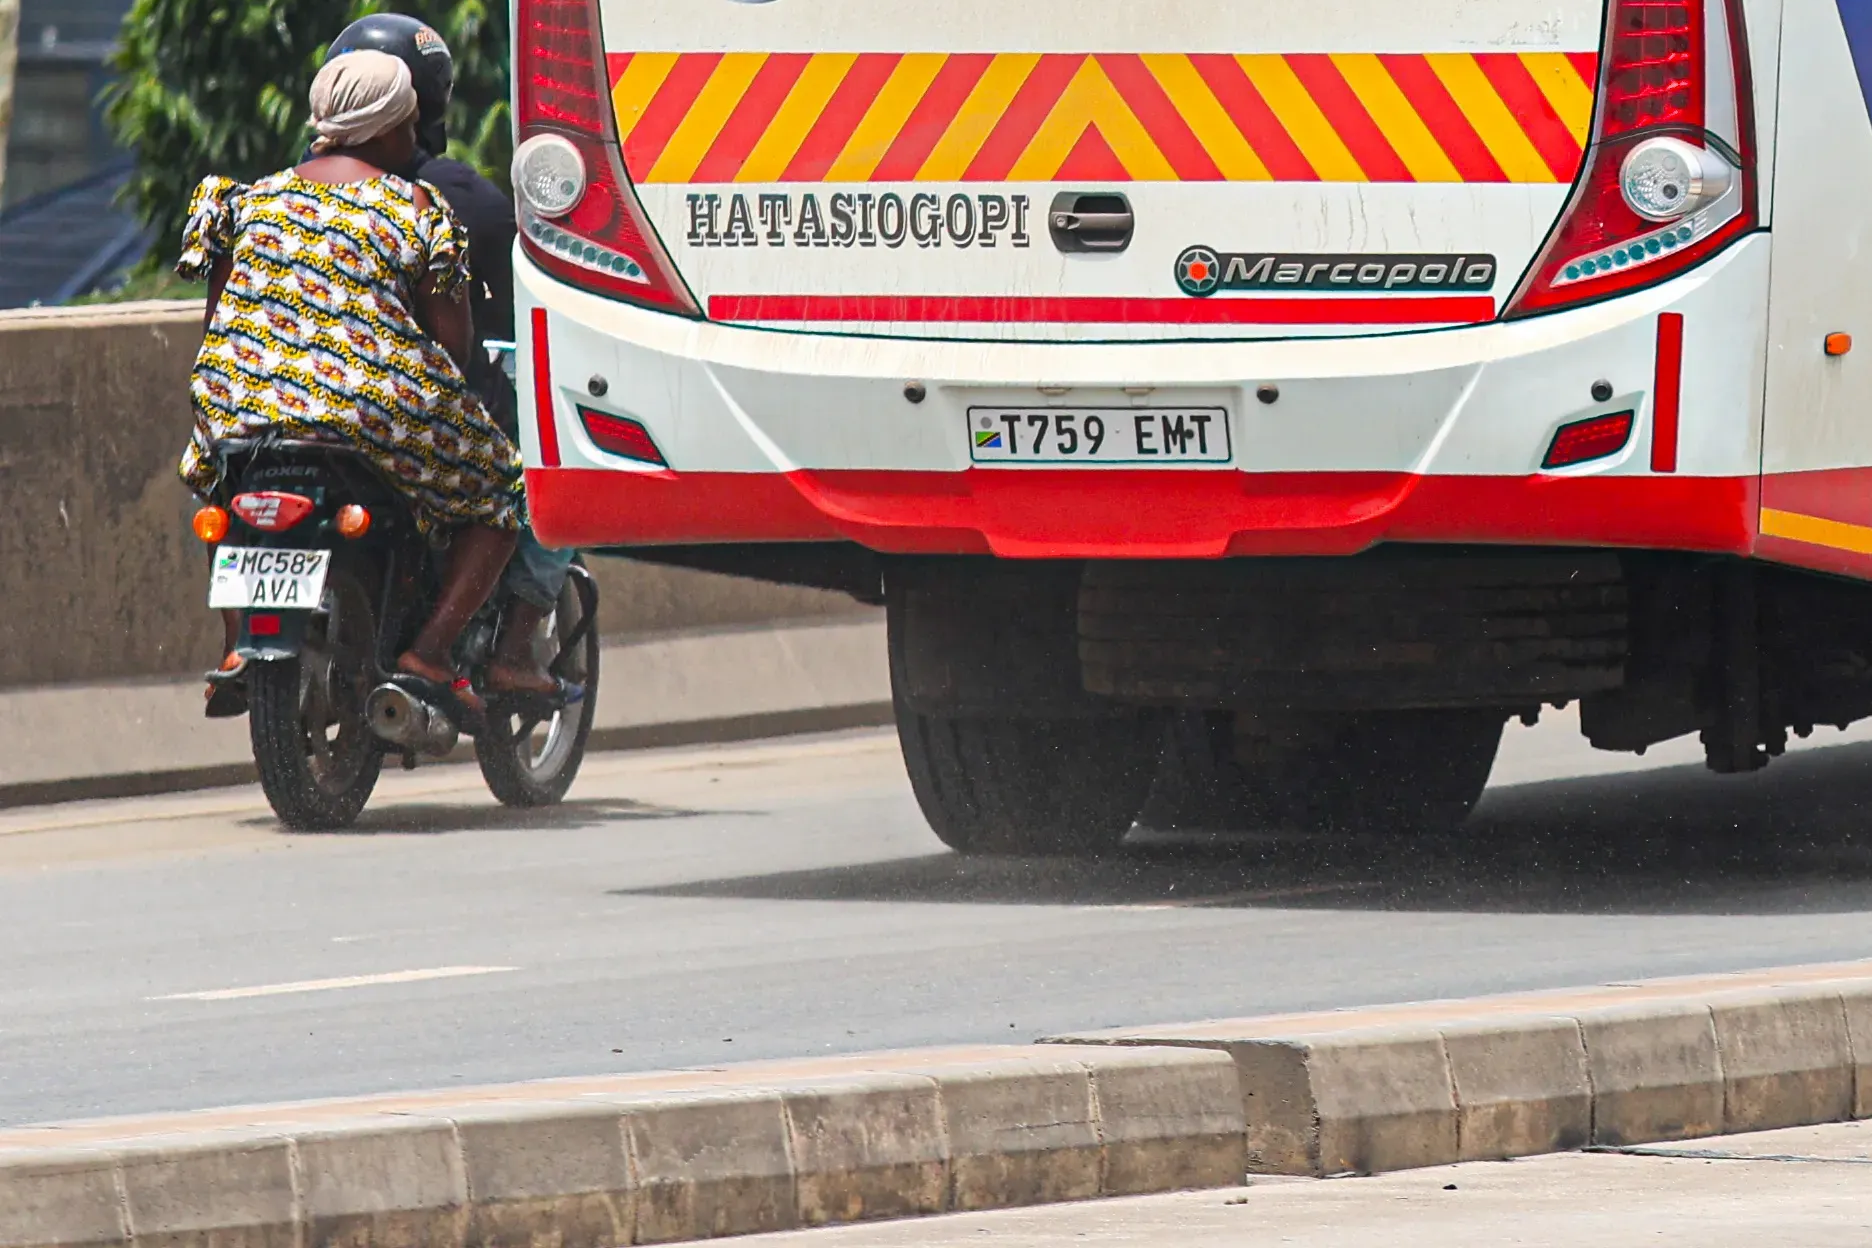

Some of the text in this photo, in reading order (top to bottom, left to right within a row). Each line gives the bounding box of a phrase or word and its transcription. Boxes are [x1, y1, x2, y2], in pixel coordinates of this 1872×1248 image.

[686, 193, 1030, 249] HATASIOGOPI
[1223, 257, 1492, 288] Marcopolo
[1000, 415, 1211, 454] T759 EMT
[252, 579, 298, 603] AVA
